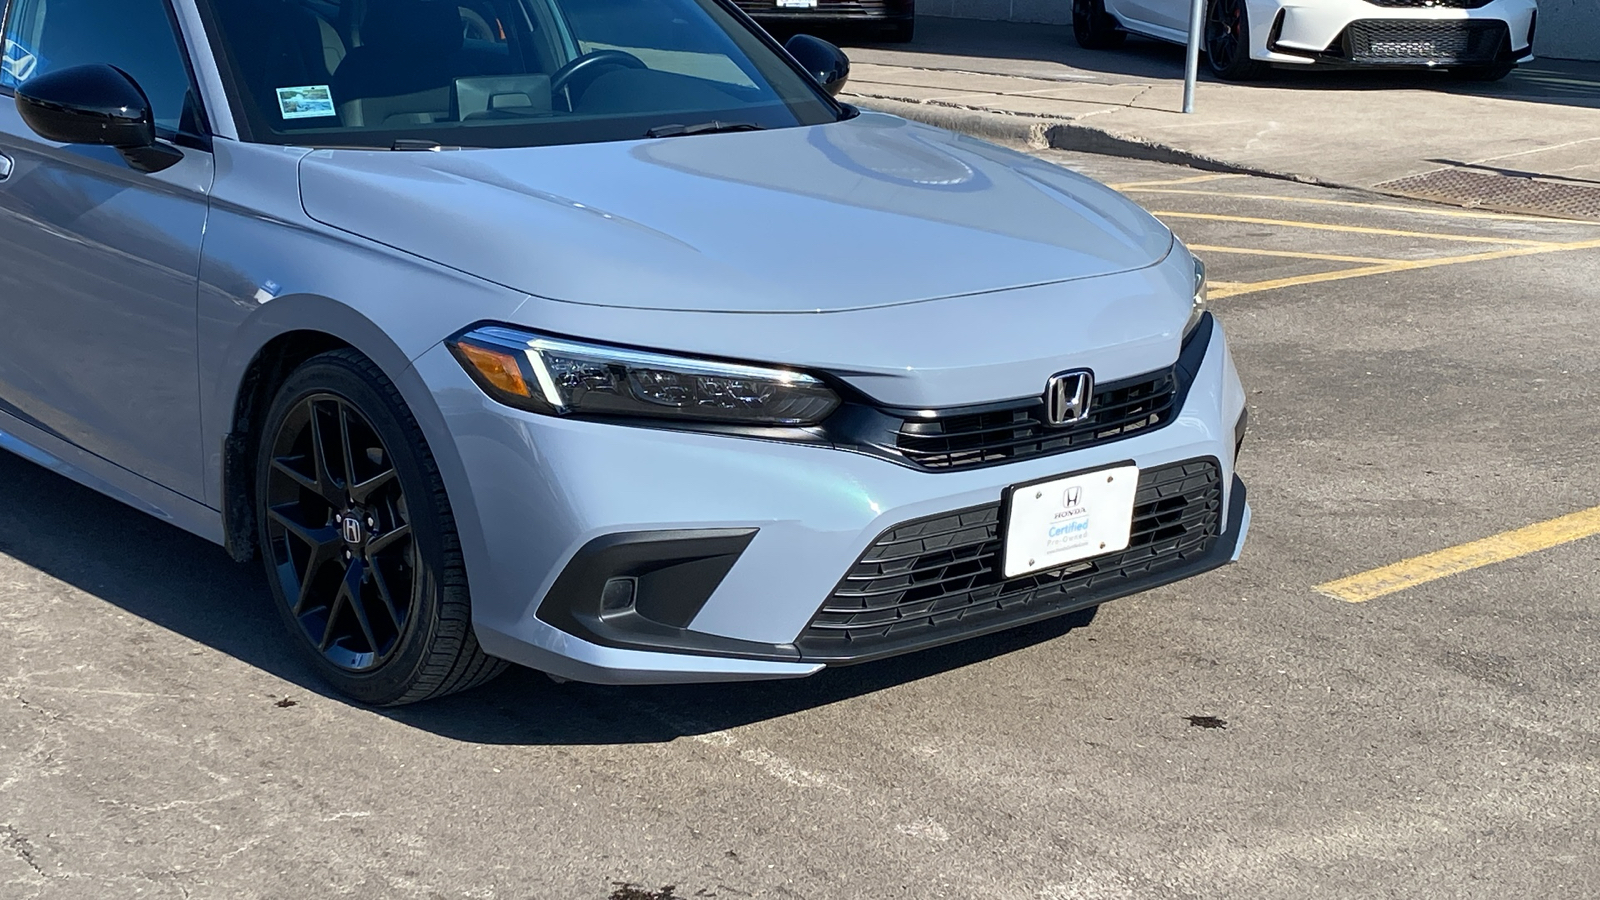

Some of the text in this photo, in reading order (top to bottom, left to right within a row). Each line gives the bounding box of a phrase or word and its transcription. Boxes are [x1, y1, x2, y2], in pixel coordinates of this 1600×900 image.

[1054, 507, 1086, 519] HONDA
[1048, 518, 1089, 538] Certified
[1047, 531, 1088, 546] Pre-Owned
